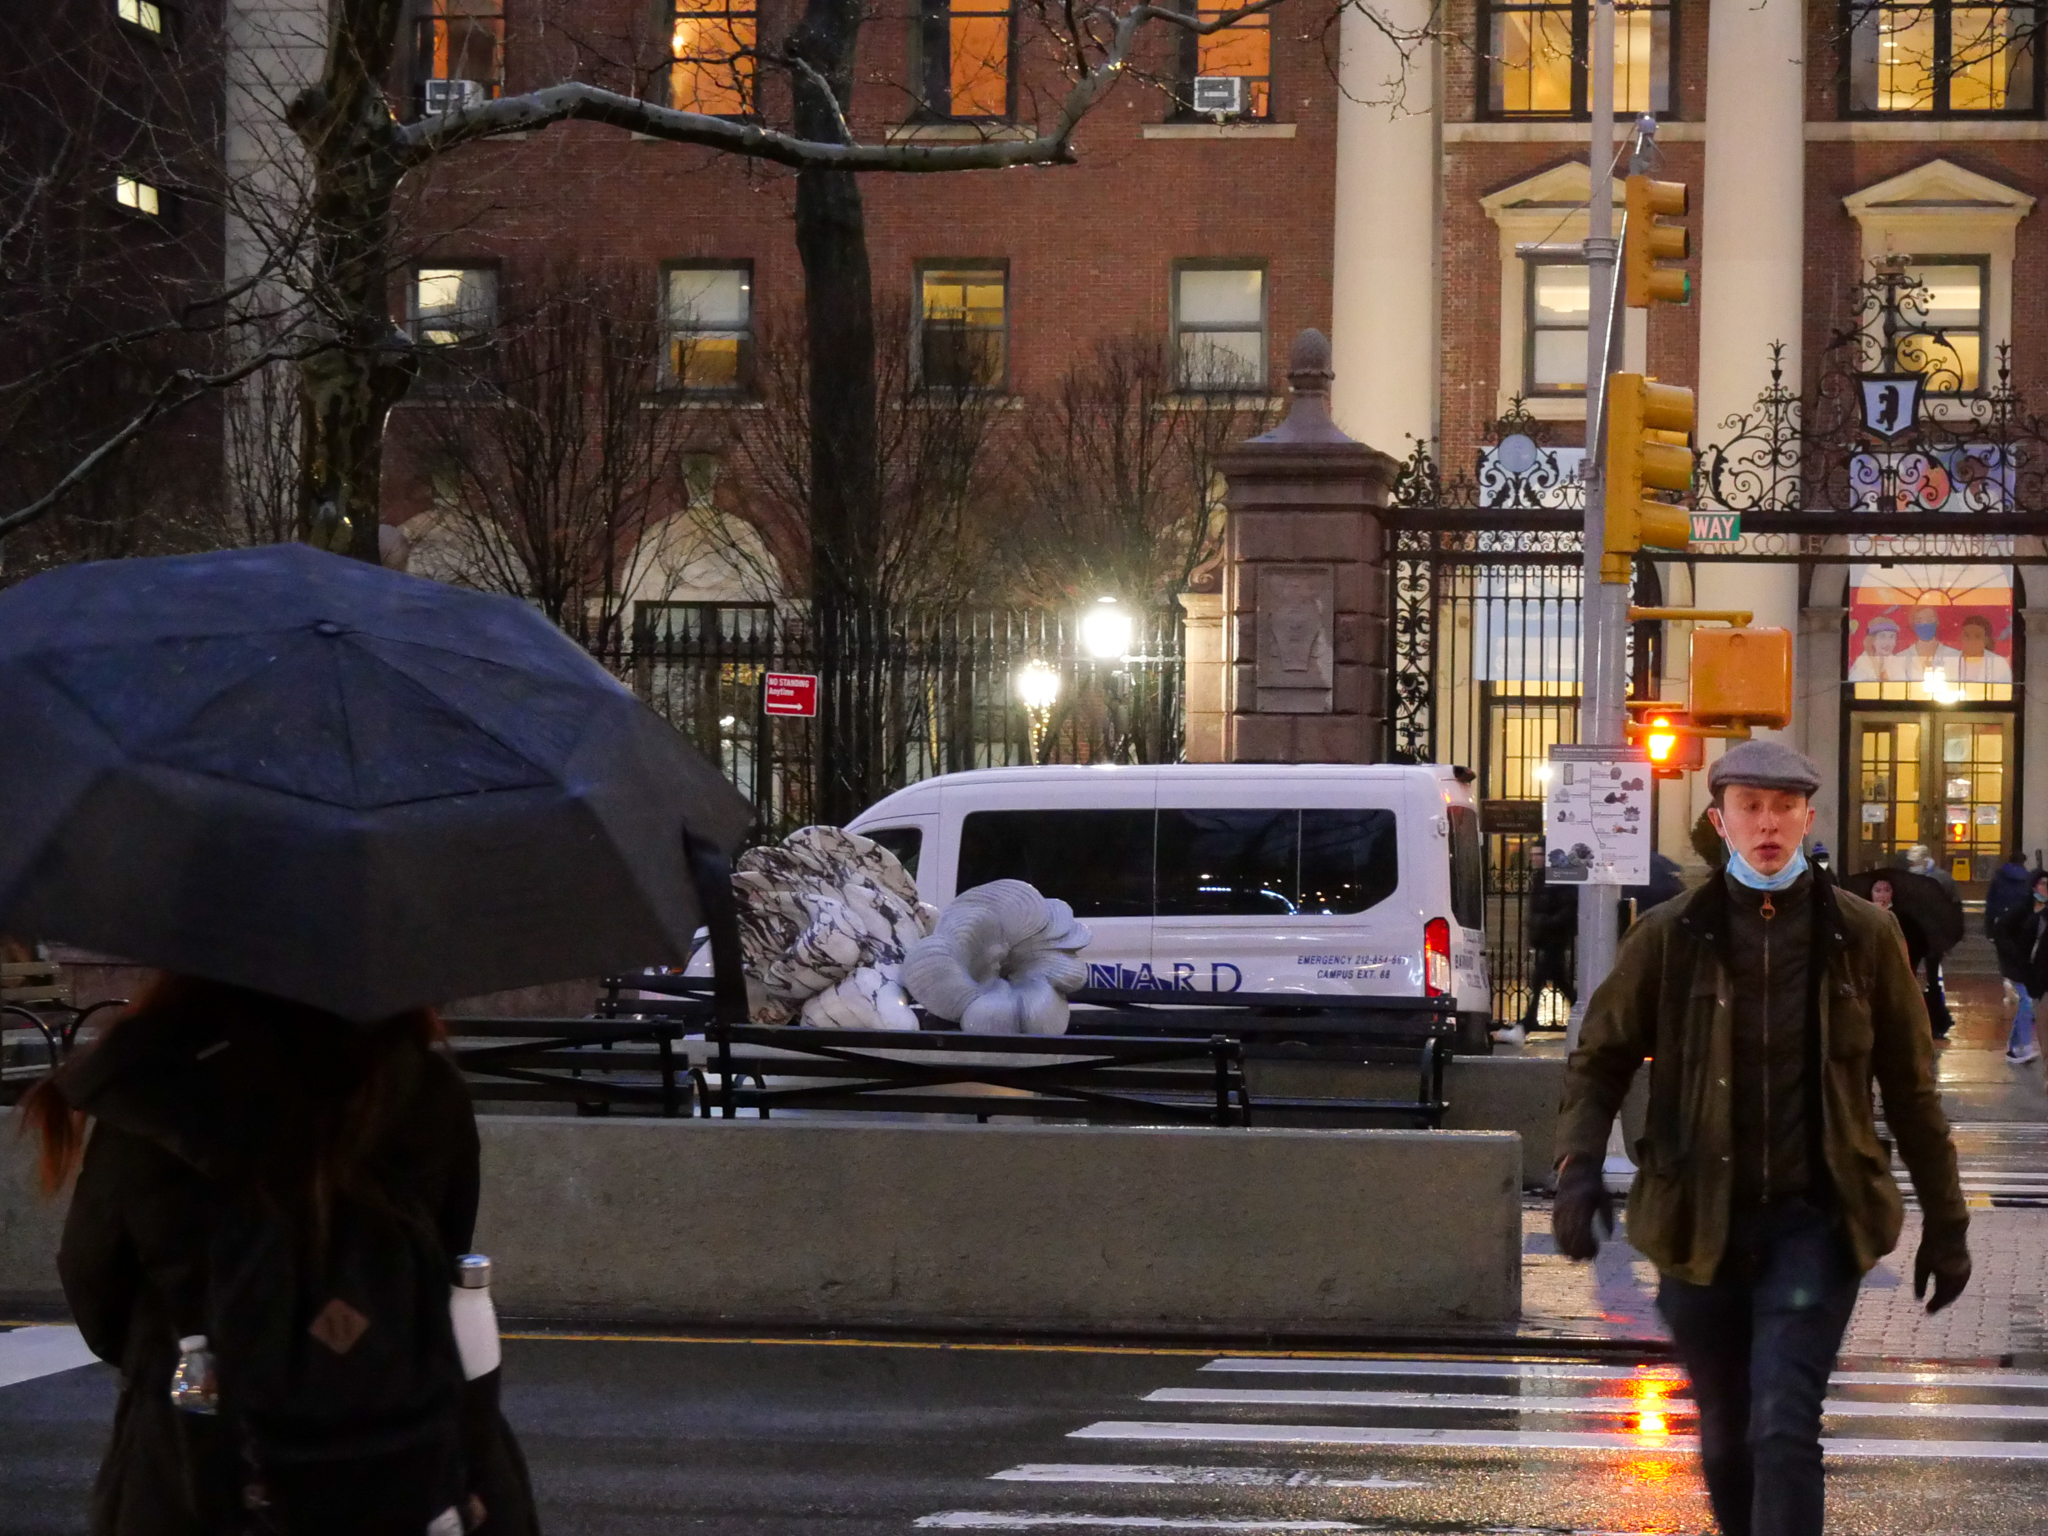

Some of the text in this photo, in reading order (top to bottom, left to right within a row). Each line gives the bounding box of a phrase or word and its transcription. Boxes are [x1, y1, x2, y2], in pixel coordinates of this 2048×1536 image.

[1693, 516, 1735, 539] WAY
[769, 677, 810, 688] NO STANDING
[768, 687, 794, 697] Anytime
[1297, 955, 1352, 965] EMERGENCY
[1317, 969, 1354, 979] CAMPUS
[1356, 970, 1376, 979] EXT.
